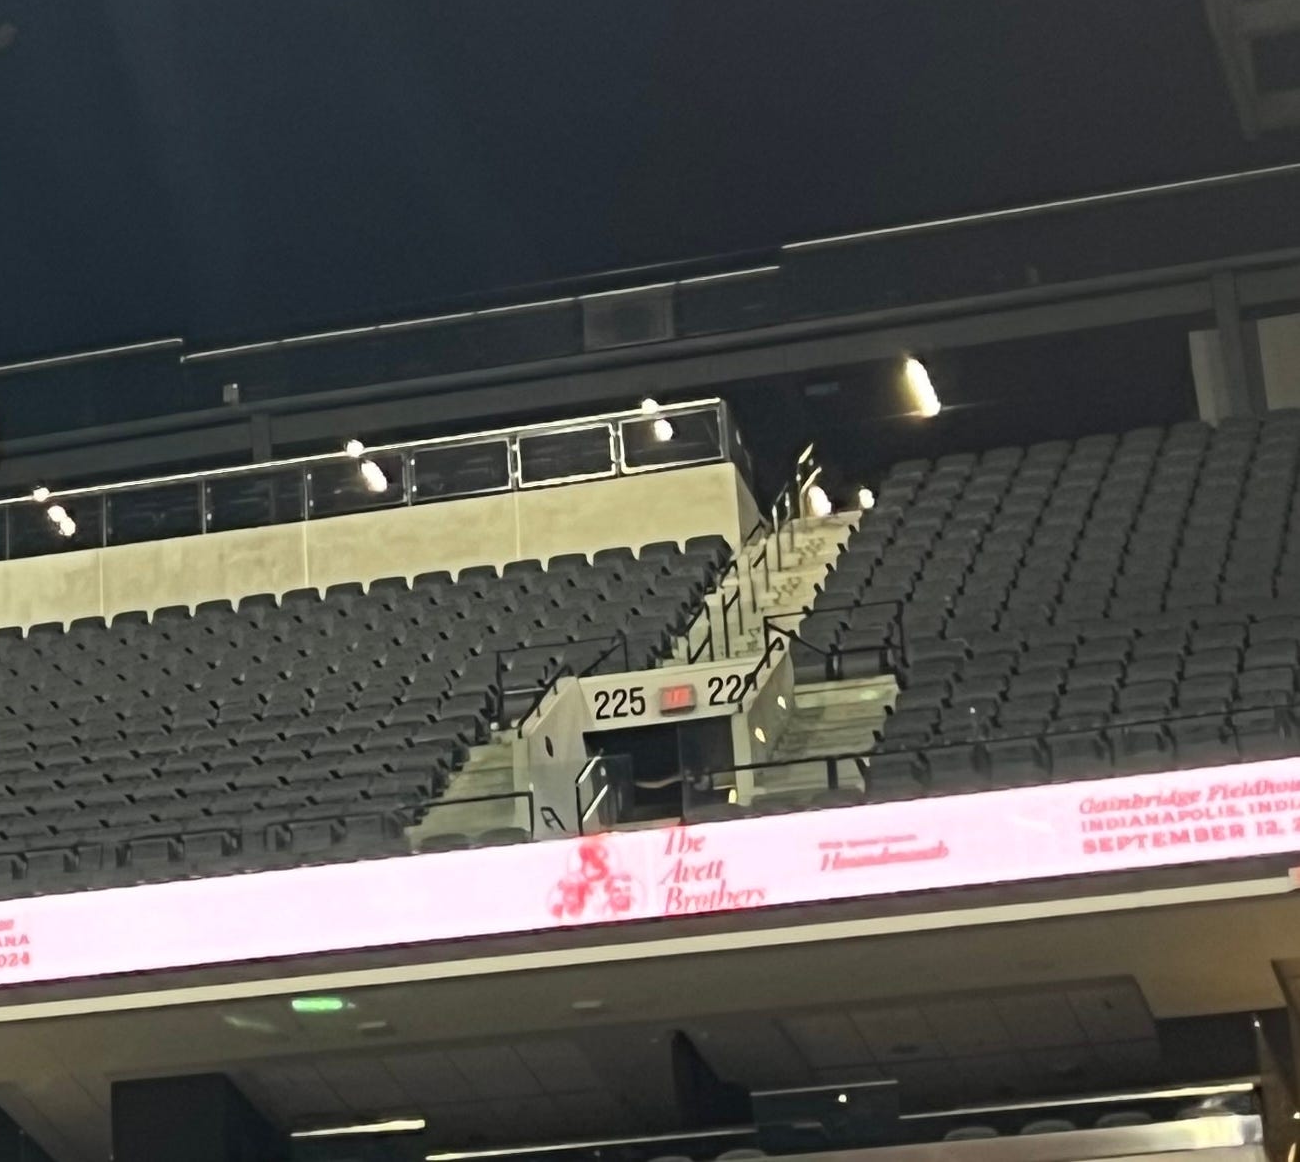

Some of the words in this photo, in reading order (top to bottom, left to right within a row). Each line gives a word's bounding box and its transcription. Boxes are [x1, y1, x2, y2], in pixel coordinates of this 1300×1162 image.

[594, 686, 646, 720] 225
[663, 824, 706, 855] The
[1083, 823, 1245, 854] SEPTEMBER
[665, 879, 765, 914] Brothers
